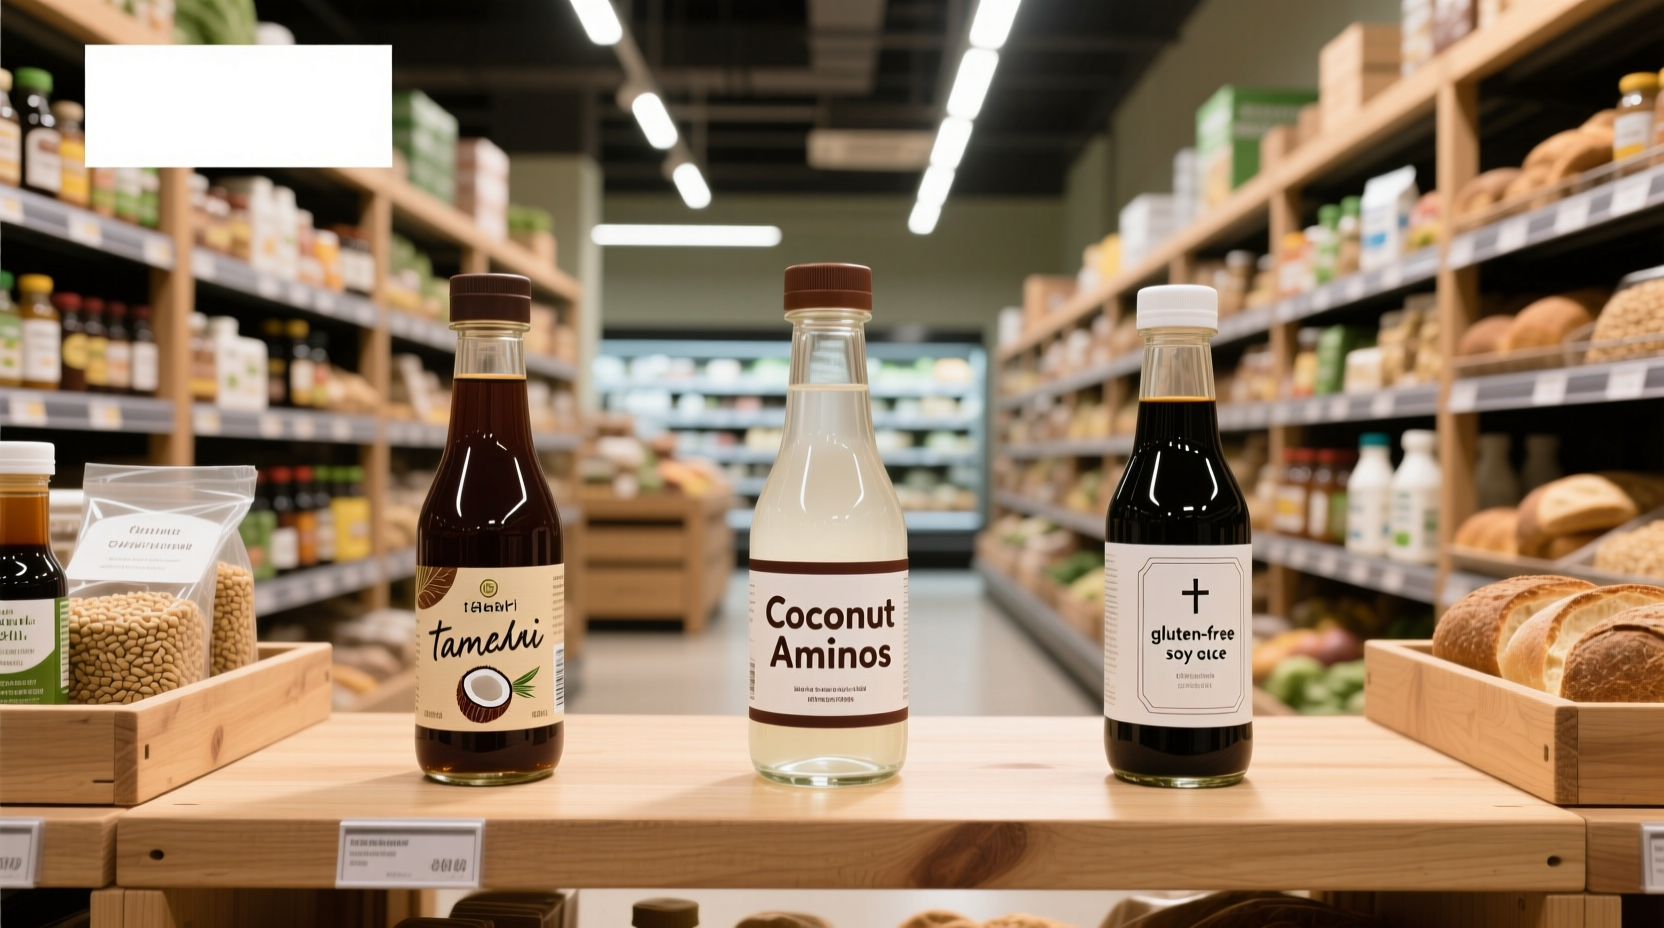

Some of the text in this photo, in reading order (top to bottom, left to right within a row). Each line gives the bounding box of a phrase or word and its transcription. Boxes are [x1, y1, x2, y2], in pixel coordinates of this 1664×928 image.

[765, 595, 896, 631] Coconut
[1151, 624, 1235, 645] gluten-free
[769, 635, 892, 670] Aminos
[1165, 649, 1193, 665] soy
